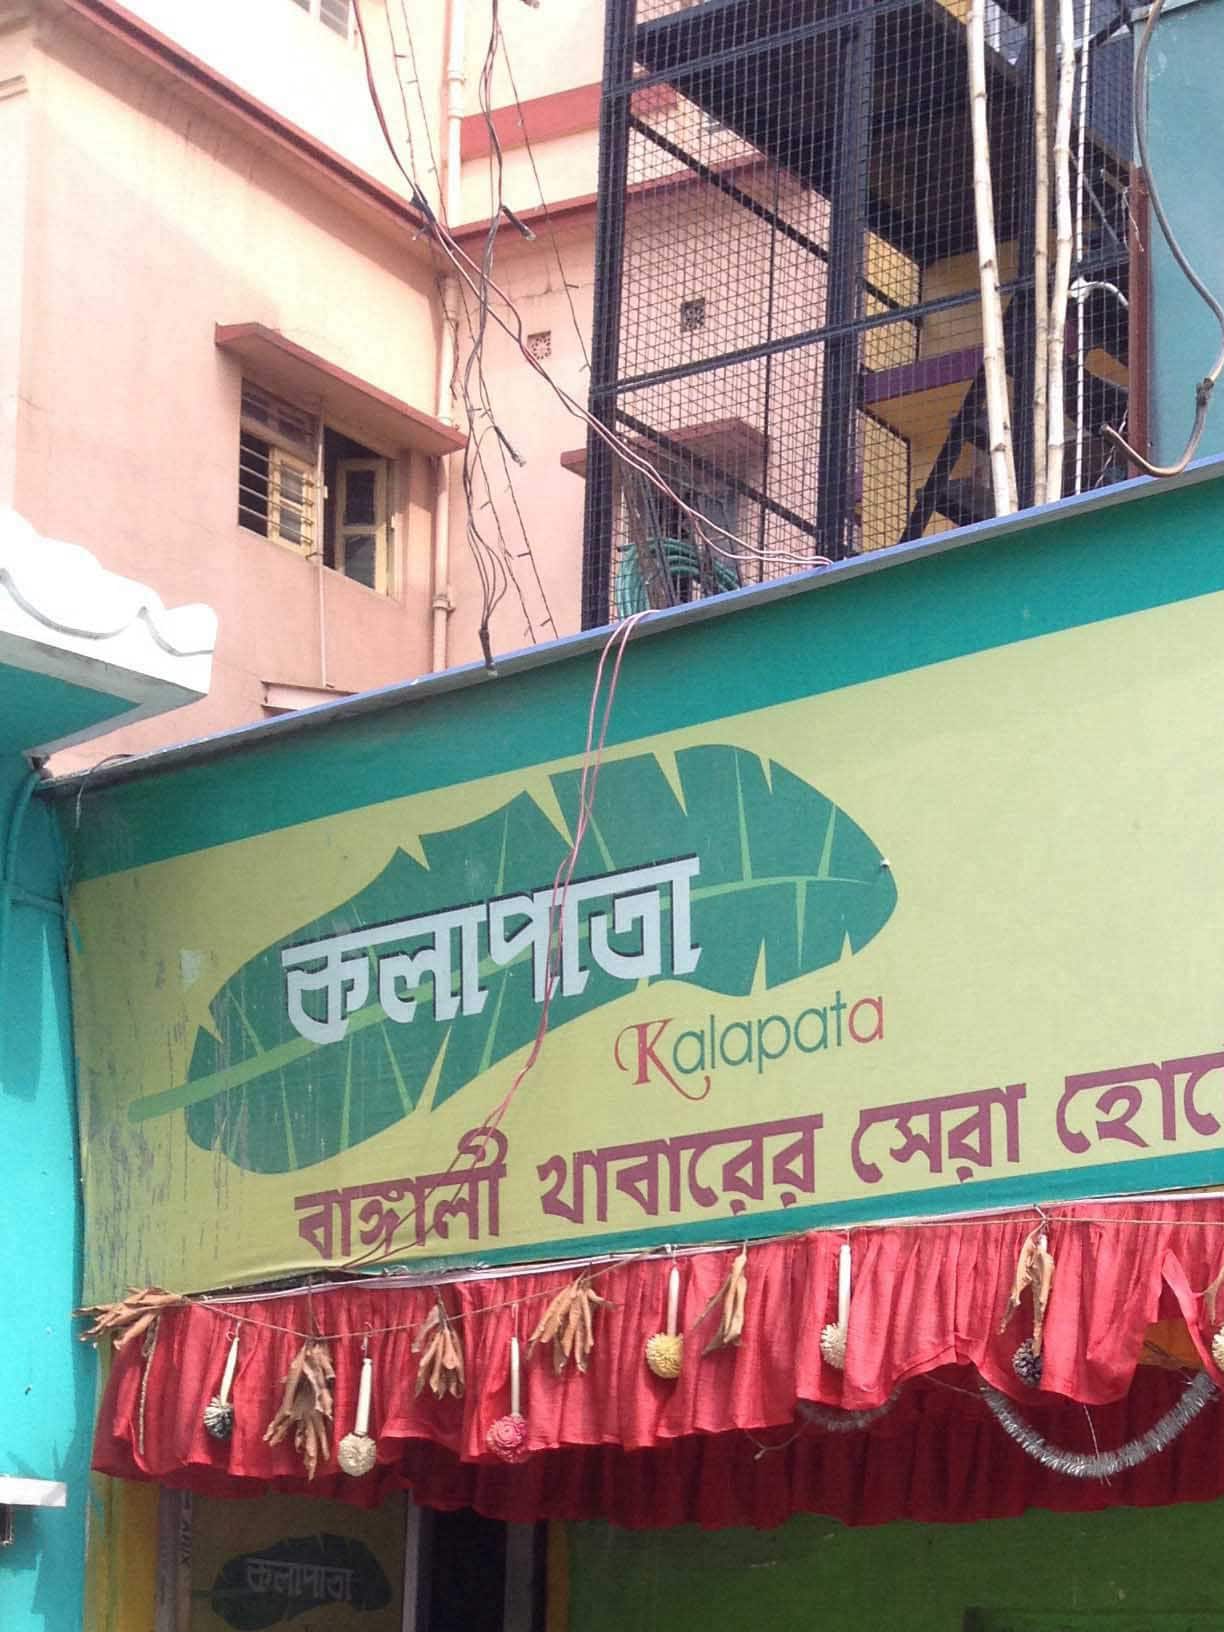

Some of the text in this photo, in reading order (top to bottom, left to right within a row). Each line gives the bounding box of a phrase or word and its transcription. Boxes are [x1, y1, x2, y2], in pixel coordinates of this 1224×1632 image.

[281, 854, 702, 1045] কলাপাতা
[614, 991, 885, 1101] Kalapata
[852, 1087, 1021, 1185] সেরা
